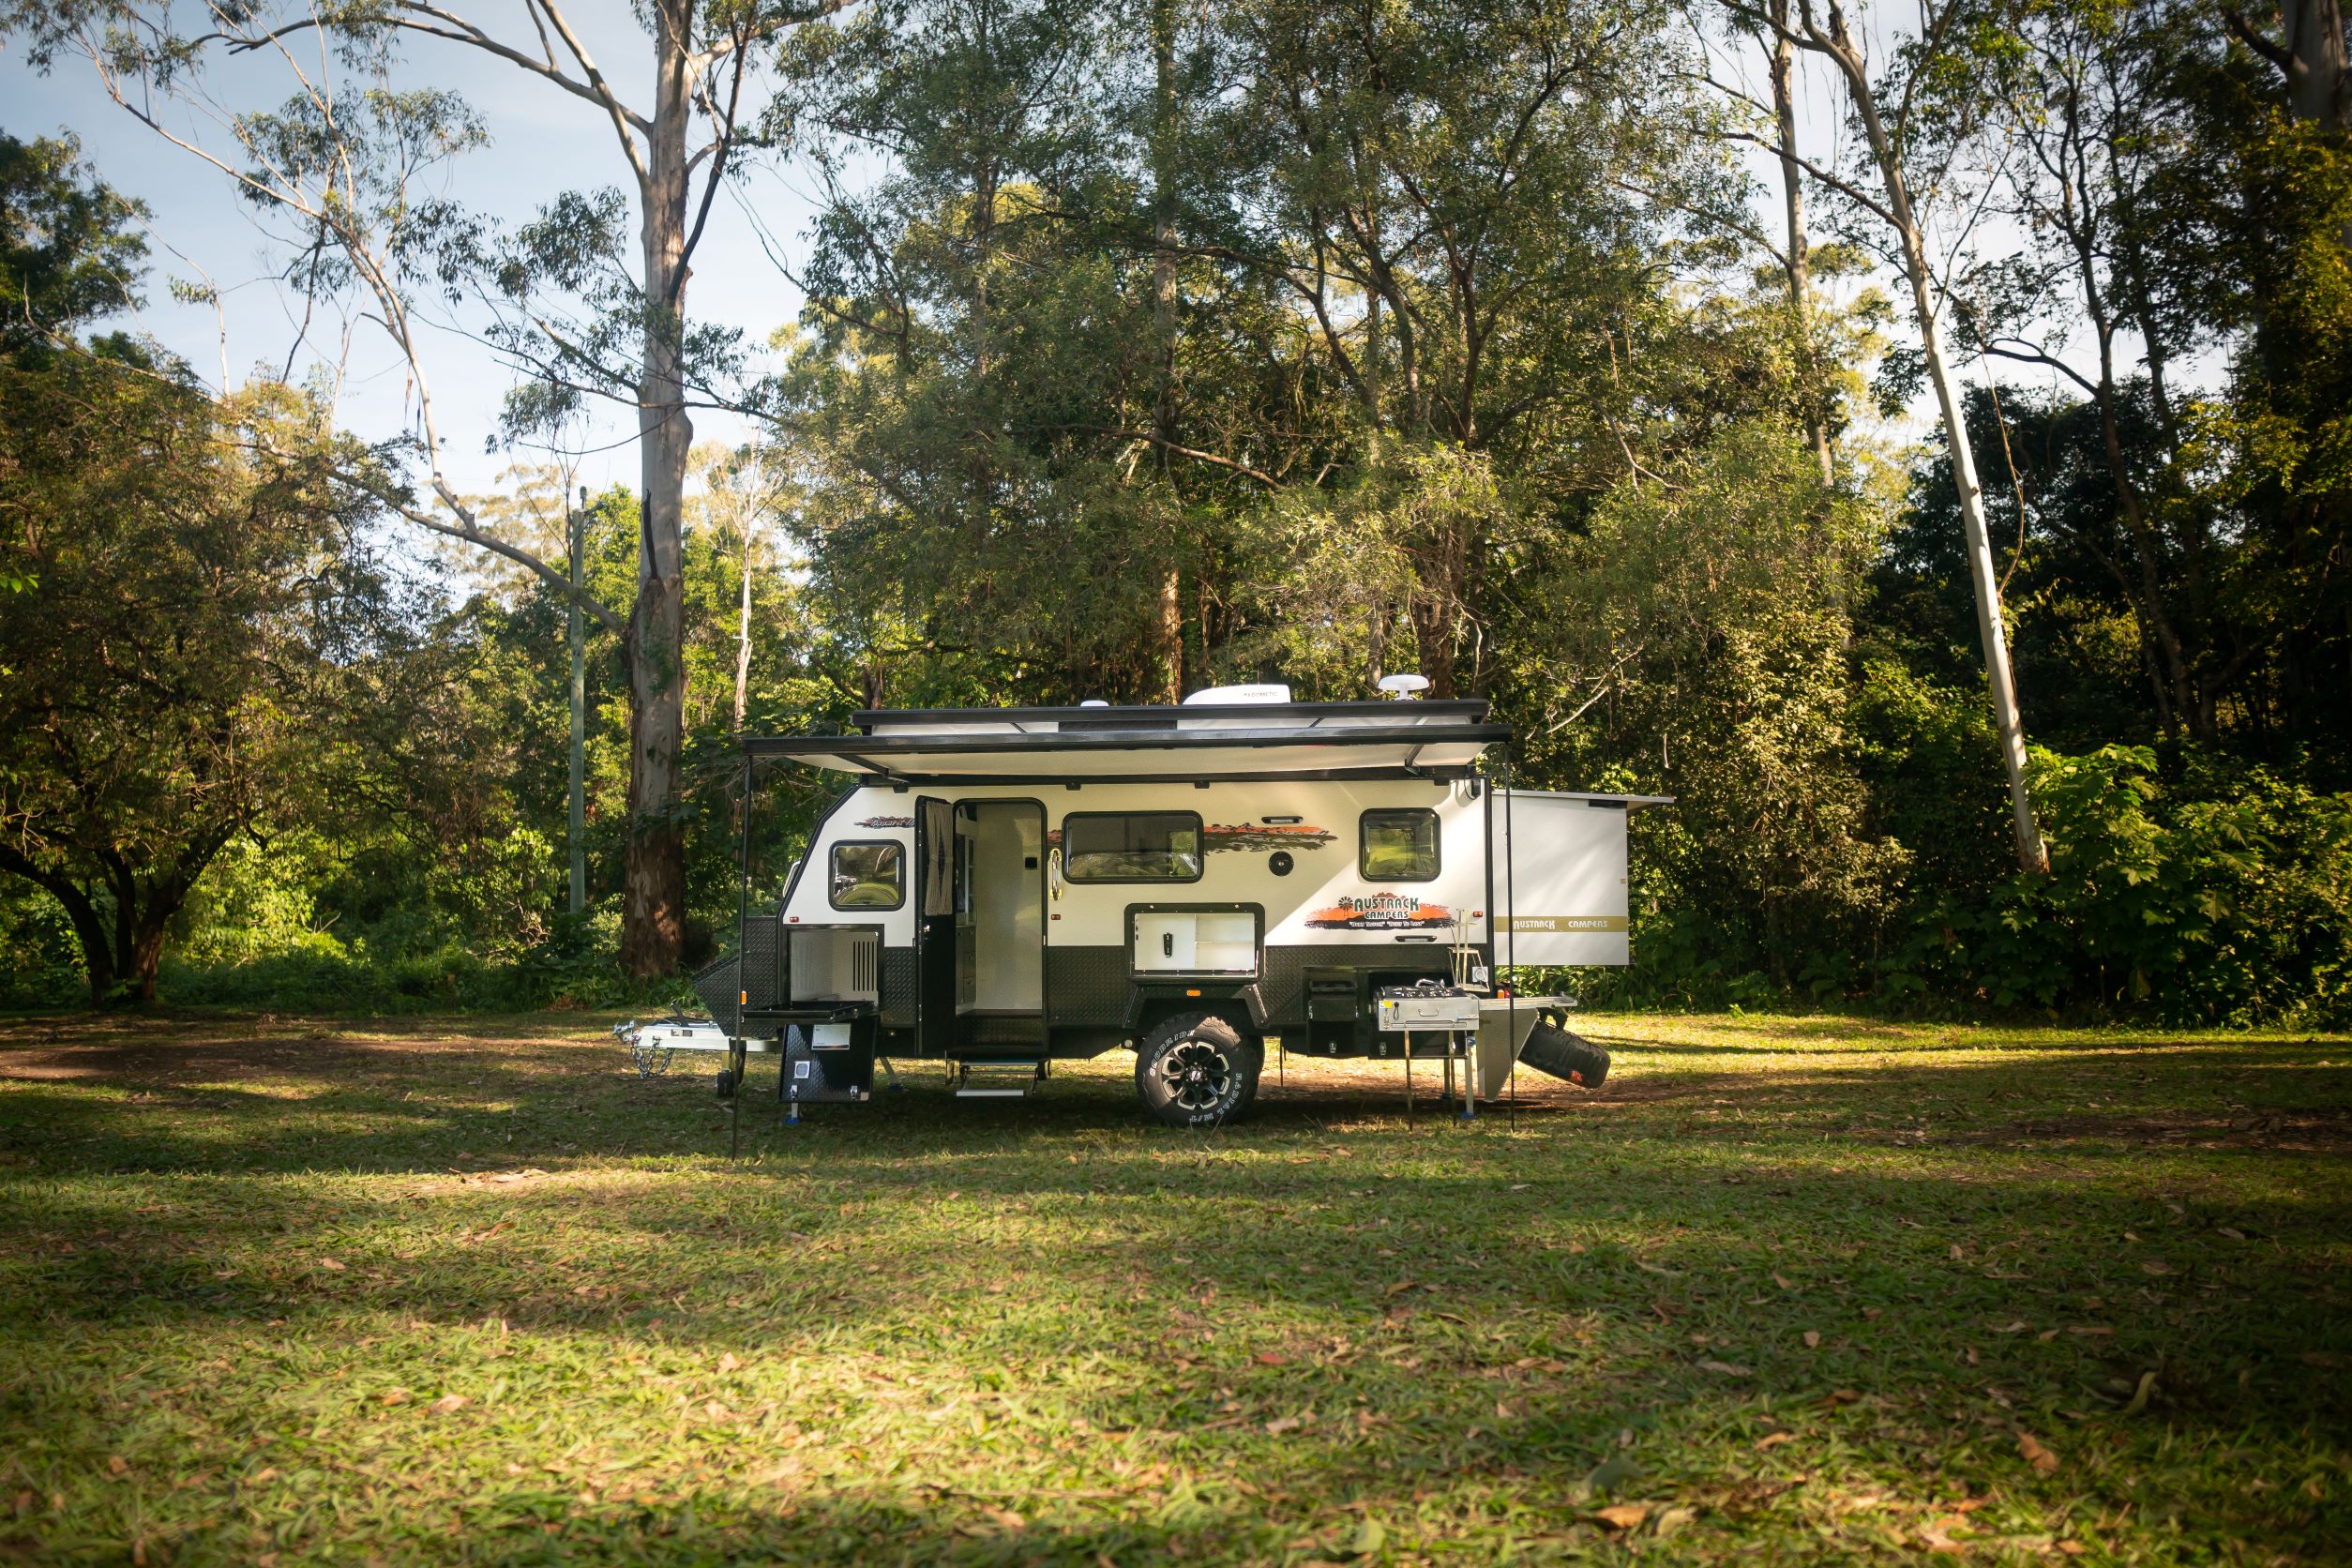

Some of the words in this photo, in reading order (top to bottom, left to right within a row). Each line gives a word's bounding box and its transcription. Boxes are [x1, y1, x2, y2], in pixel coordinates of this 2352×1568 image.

[1353, 897, 1420, 912] AUSTRACK
[1364, 911, 1410, 919] CAMPERS
[1514, 920, 1556, 930] AUSTRACK
[1568, 920, 1608, 928] CAMPERS
[1217, 1073, 1243, 1115] RADIAL
